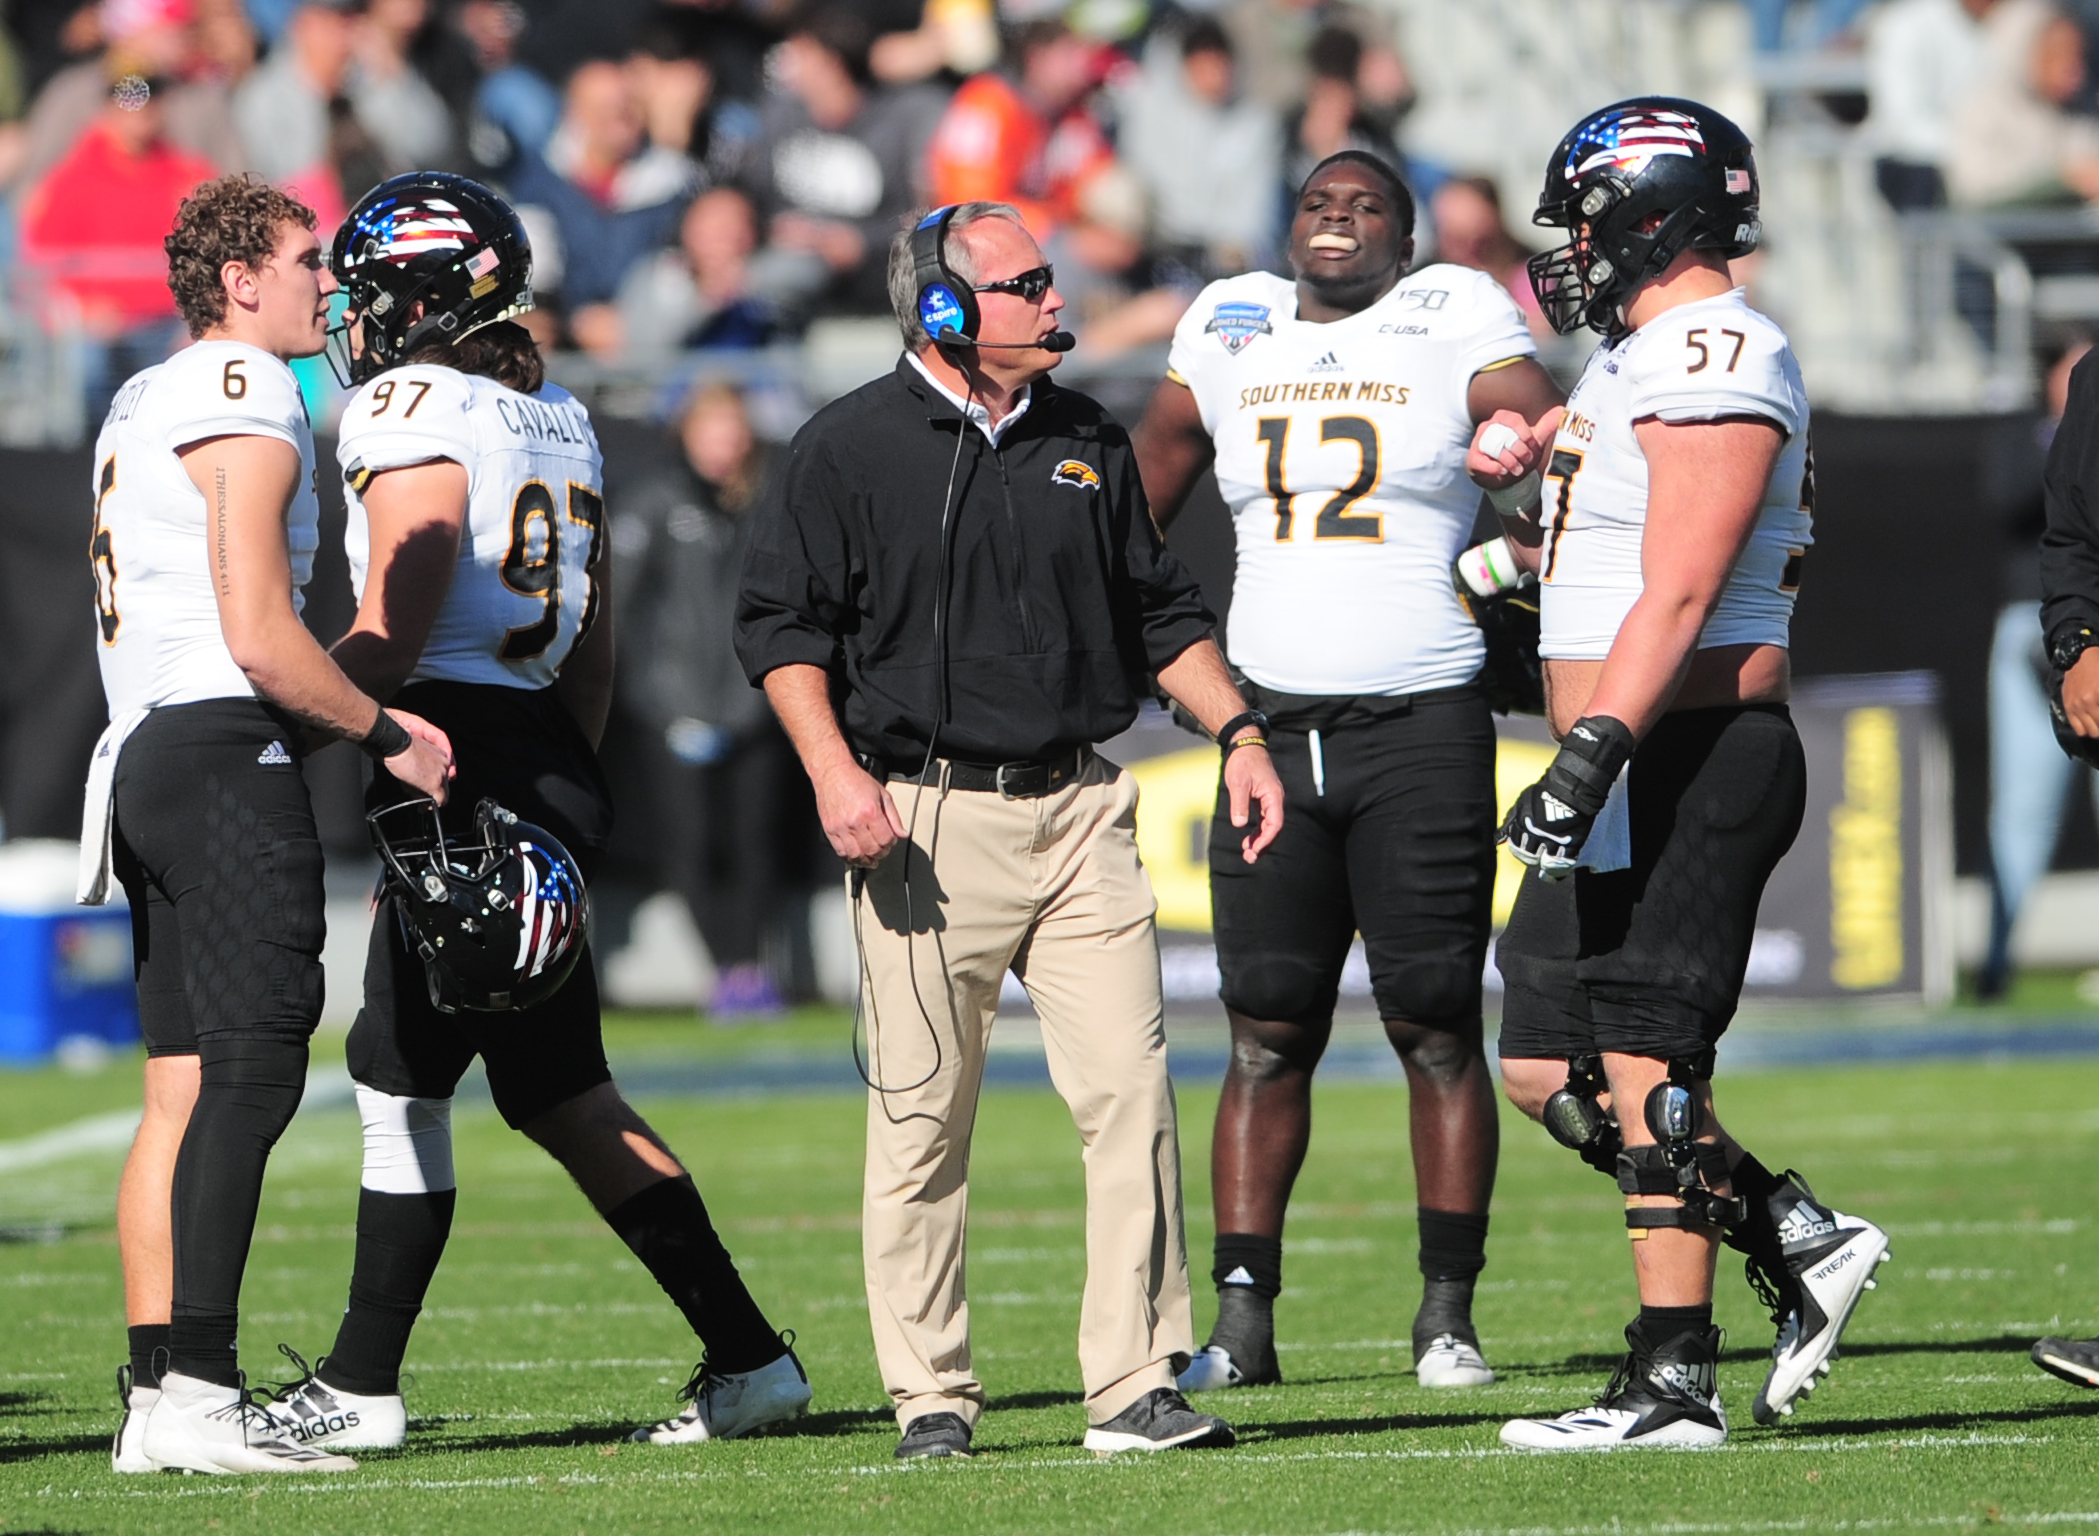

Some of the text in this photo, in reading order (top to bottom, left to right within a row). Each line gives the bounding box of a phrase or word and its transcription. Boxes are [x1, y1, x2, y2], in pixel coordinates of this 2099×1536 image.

[933, 307, 958, 322] spire
[1686, 327, 1746, 375] 57
[223, 359, 247, 400] 6
[1239, 380, 1411, 411] SOUTHERN MISS
[371, 380, 433, 419] 97
[1566, 410, 1596, 443] MISS
[1255, 414, 1386, 544] 12
[220, 572, 231, 597] 4:11
[499, 478, 604, 673] 97
[257, 754, 292, 765] adida
[1662, 1365, 1709, 1407] adidas
[280, 1411, 361, 1442] didas
